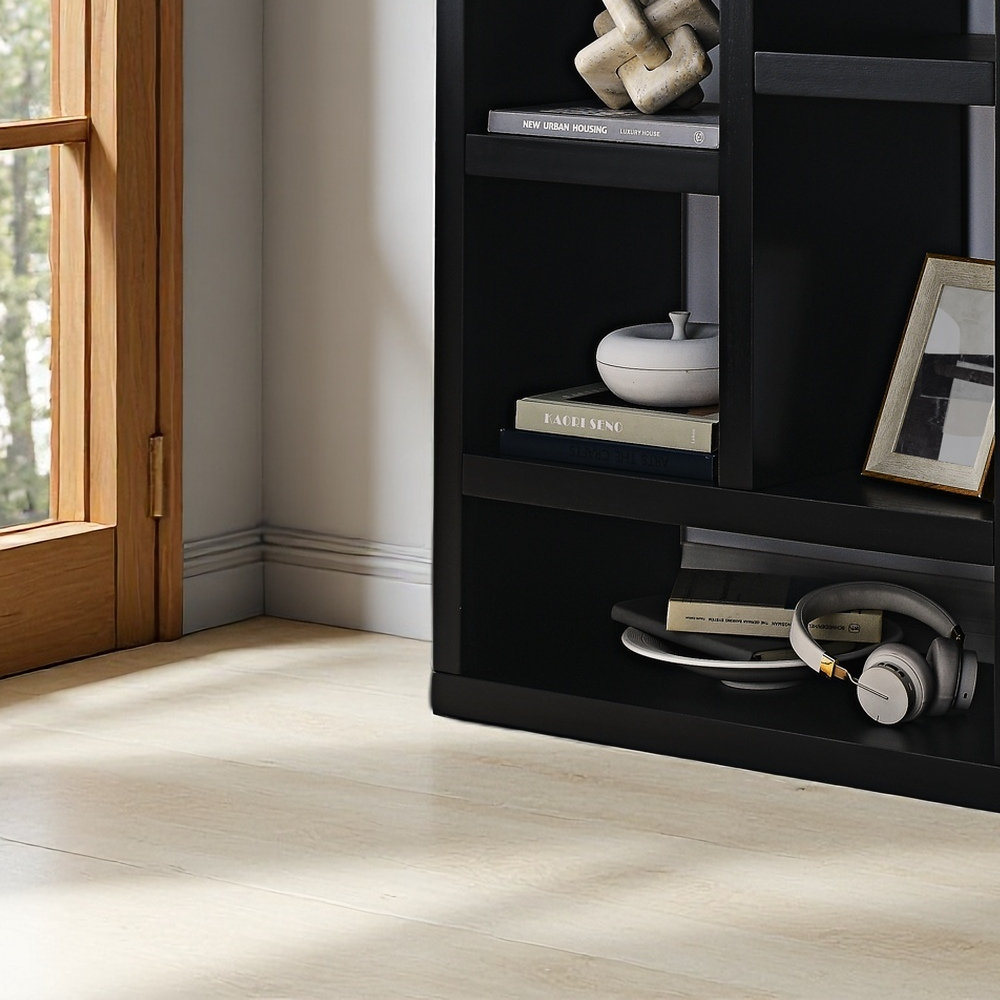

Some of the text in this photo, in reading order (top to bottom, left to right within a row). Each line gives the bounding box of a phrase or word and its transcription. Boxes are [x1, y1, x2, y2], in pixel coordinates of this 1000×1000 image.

[522, 119, 608, 135] NEW URBAN HOUSING
[543, 413, 586, 428] KAORI
